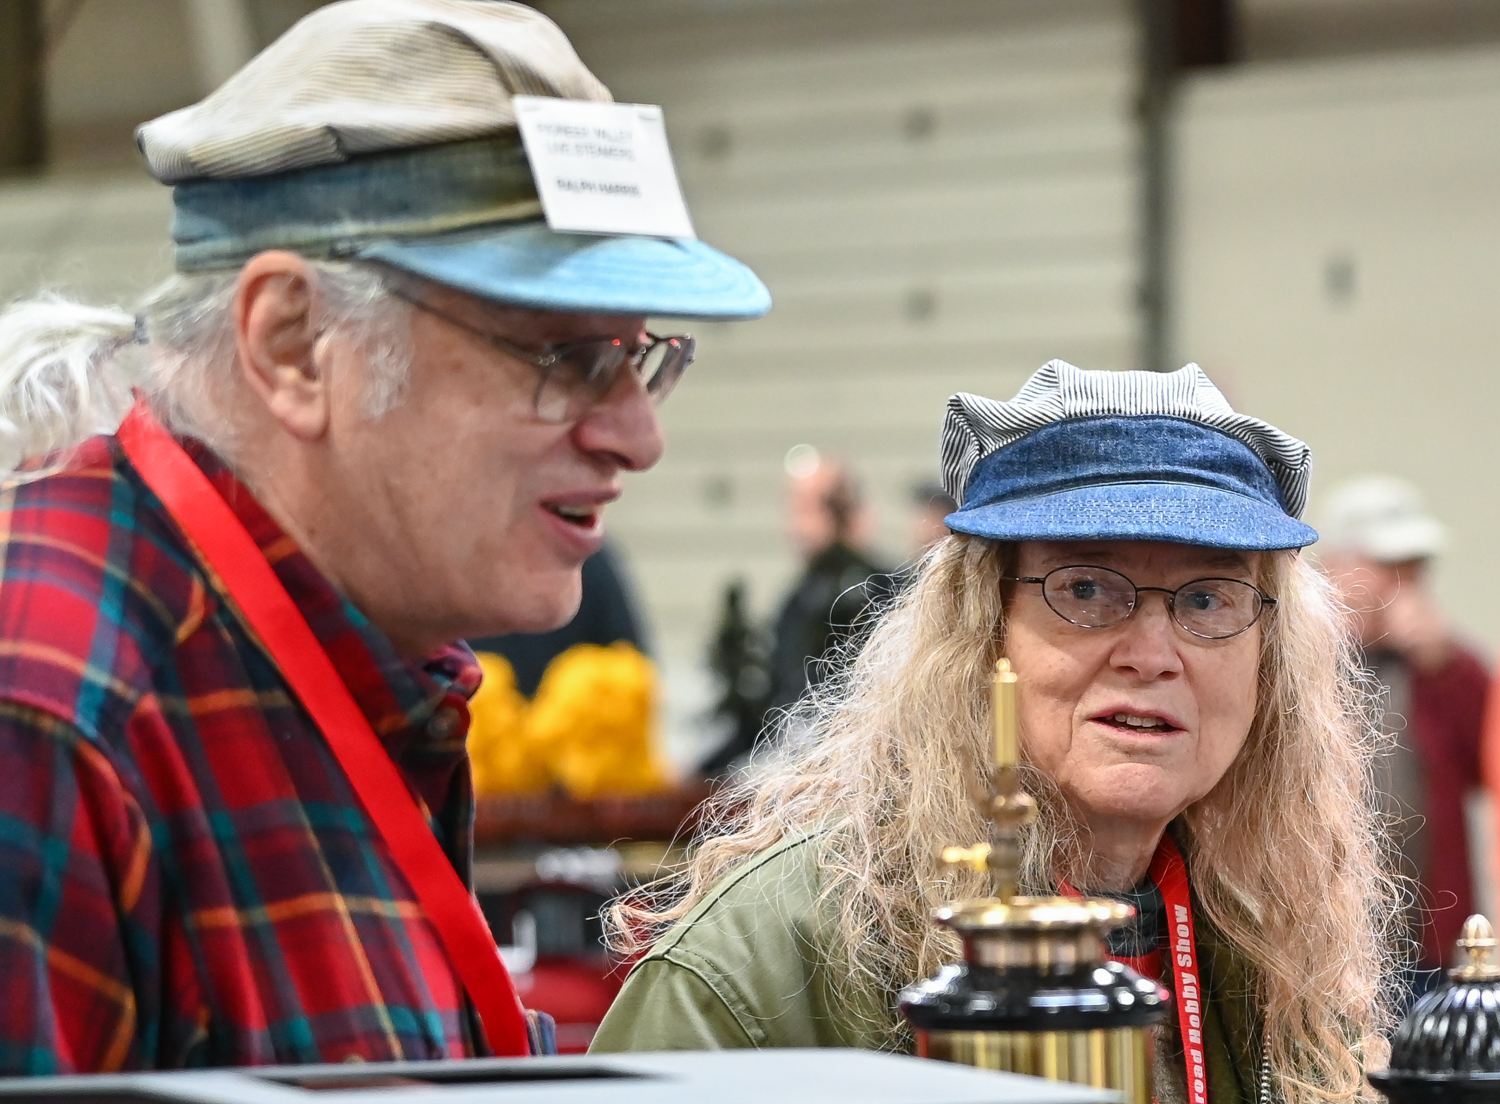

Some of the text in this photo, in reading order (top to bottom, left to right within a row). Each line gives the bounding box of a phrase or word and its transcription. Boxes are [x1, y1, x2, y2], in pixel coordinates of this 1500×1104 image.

[556, 178, 641, 198] RALPH HARRIS
[1173, 904, 1193, 968] Show
[1180, 971, 1201, 1044] Hobby
